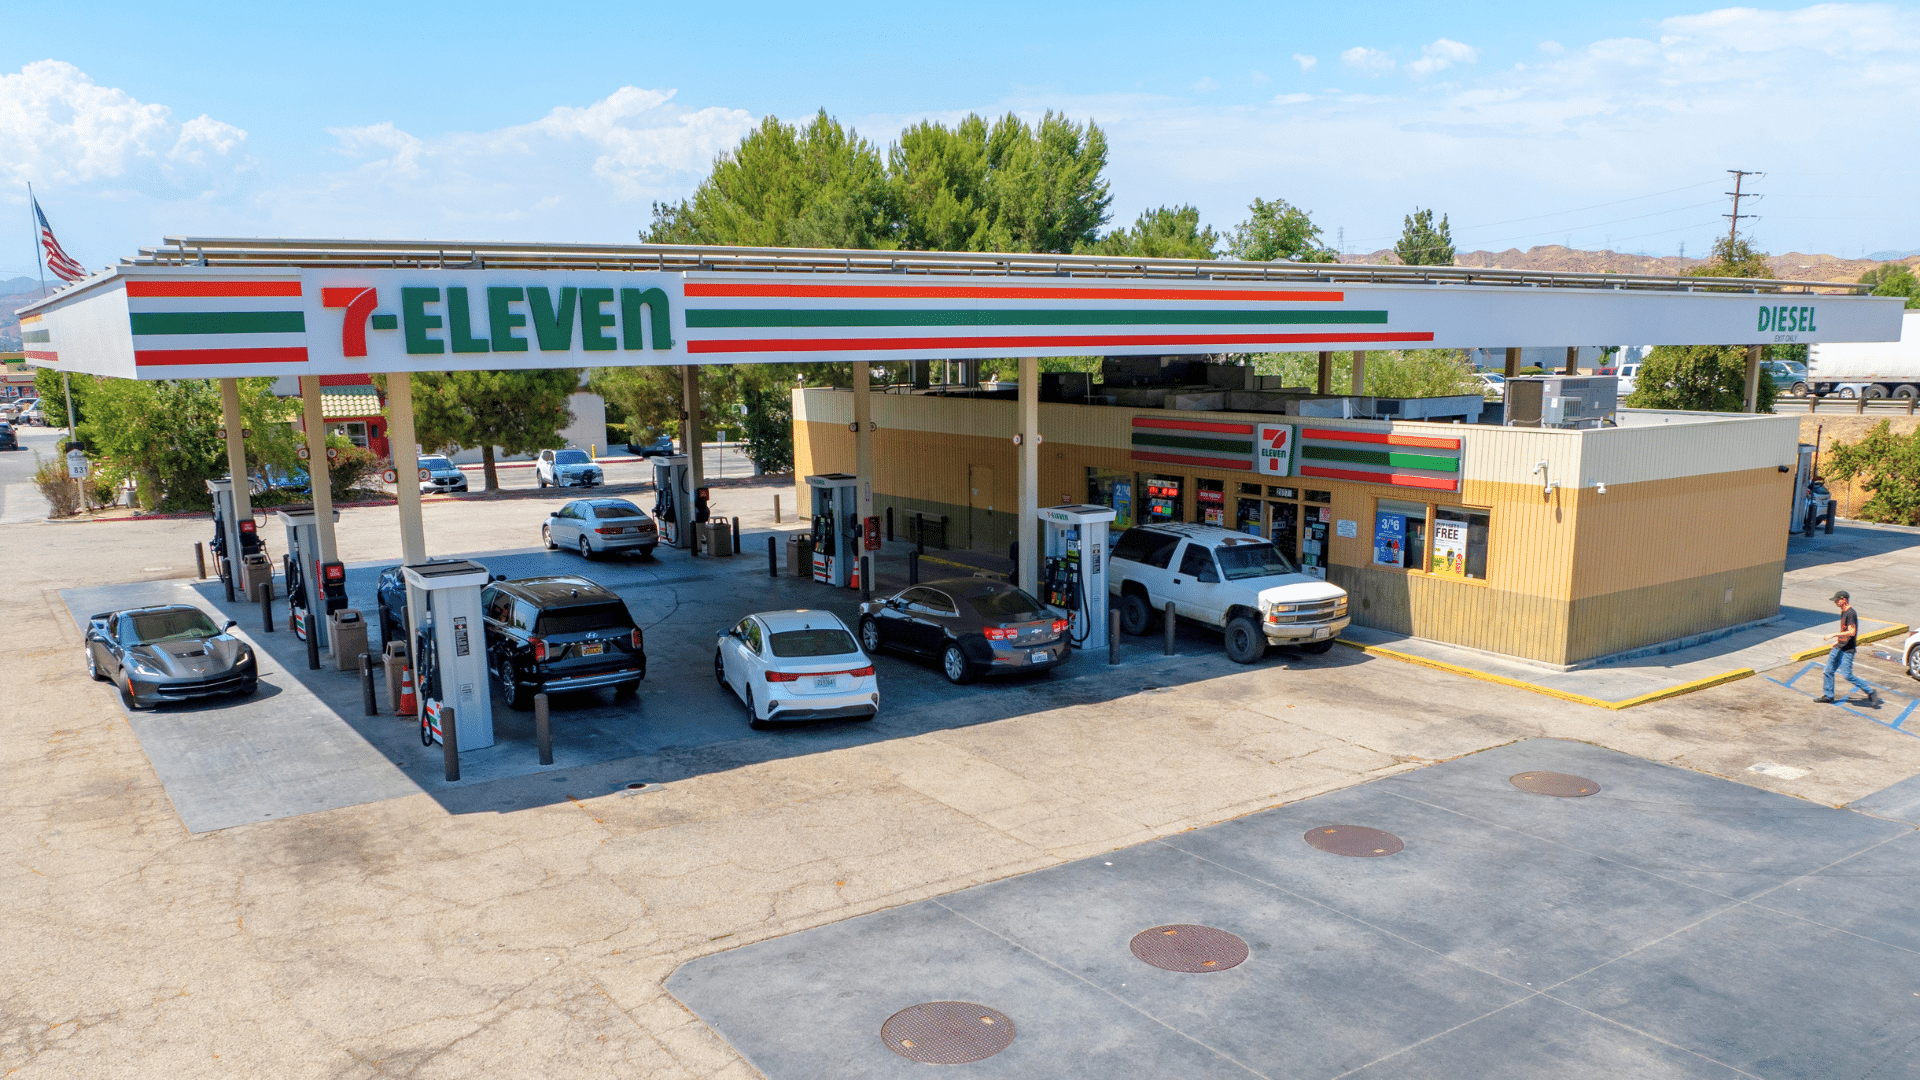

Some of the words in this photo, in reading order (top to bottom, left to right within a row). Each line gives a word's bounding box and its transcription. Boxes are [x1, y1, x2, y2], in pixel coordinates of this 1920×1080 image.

[1757, 305, 1817, 332] DIESEL
[1774, 334, 1786, 343] EXIT
[1785, 334, 1798, 343] ONLY
[1381, 518, 1400, 531] 3/$6
[1436, 527, 1459, 540] FREE
